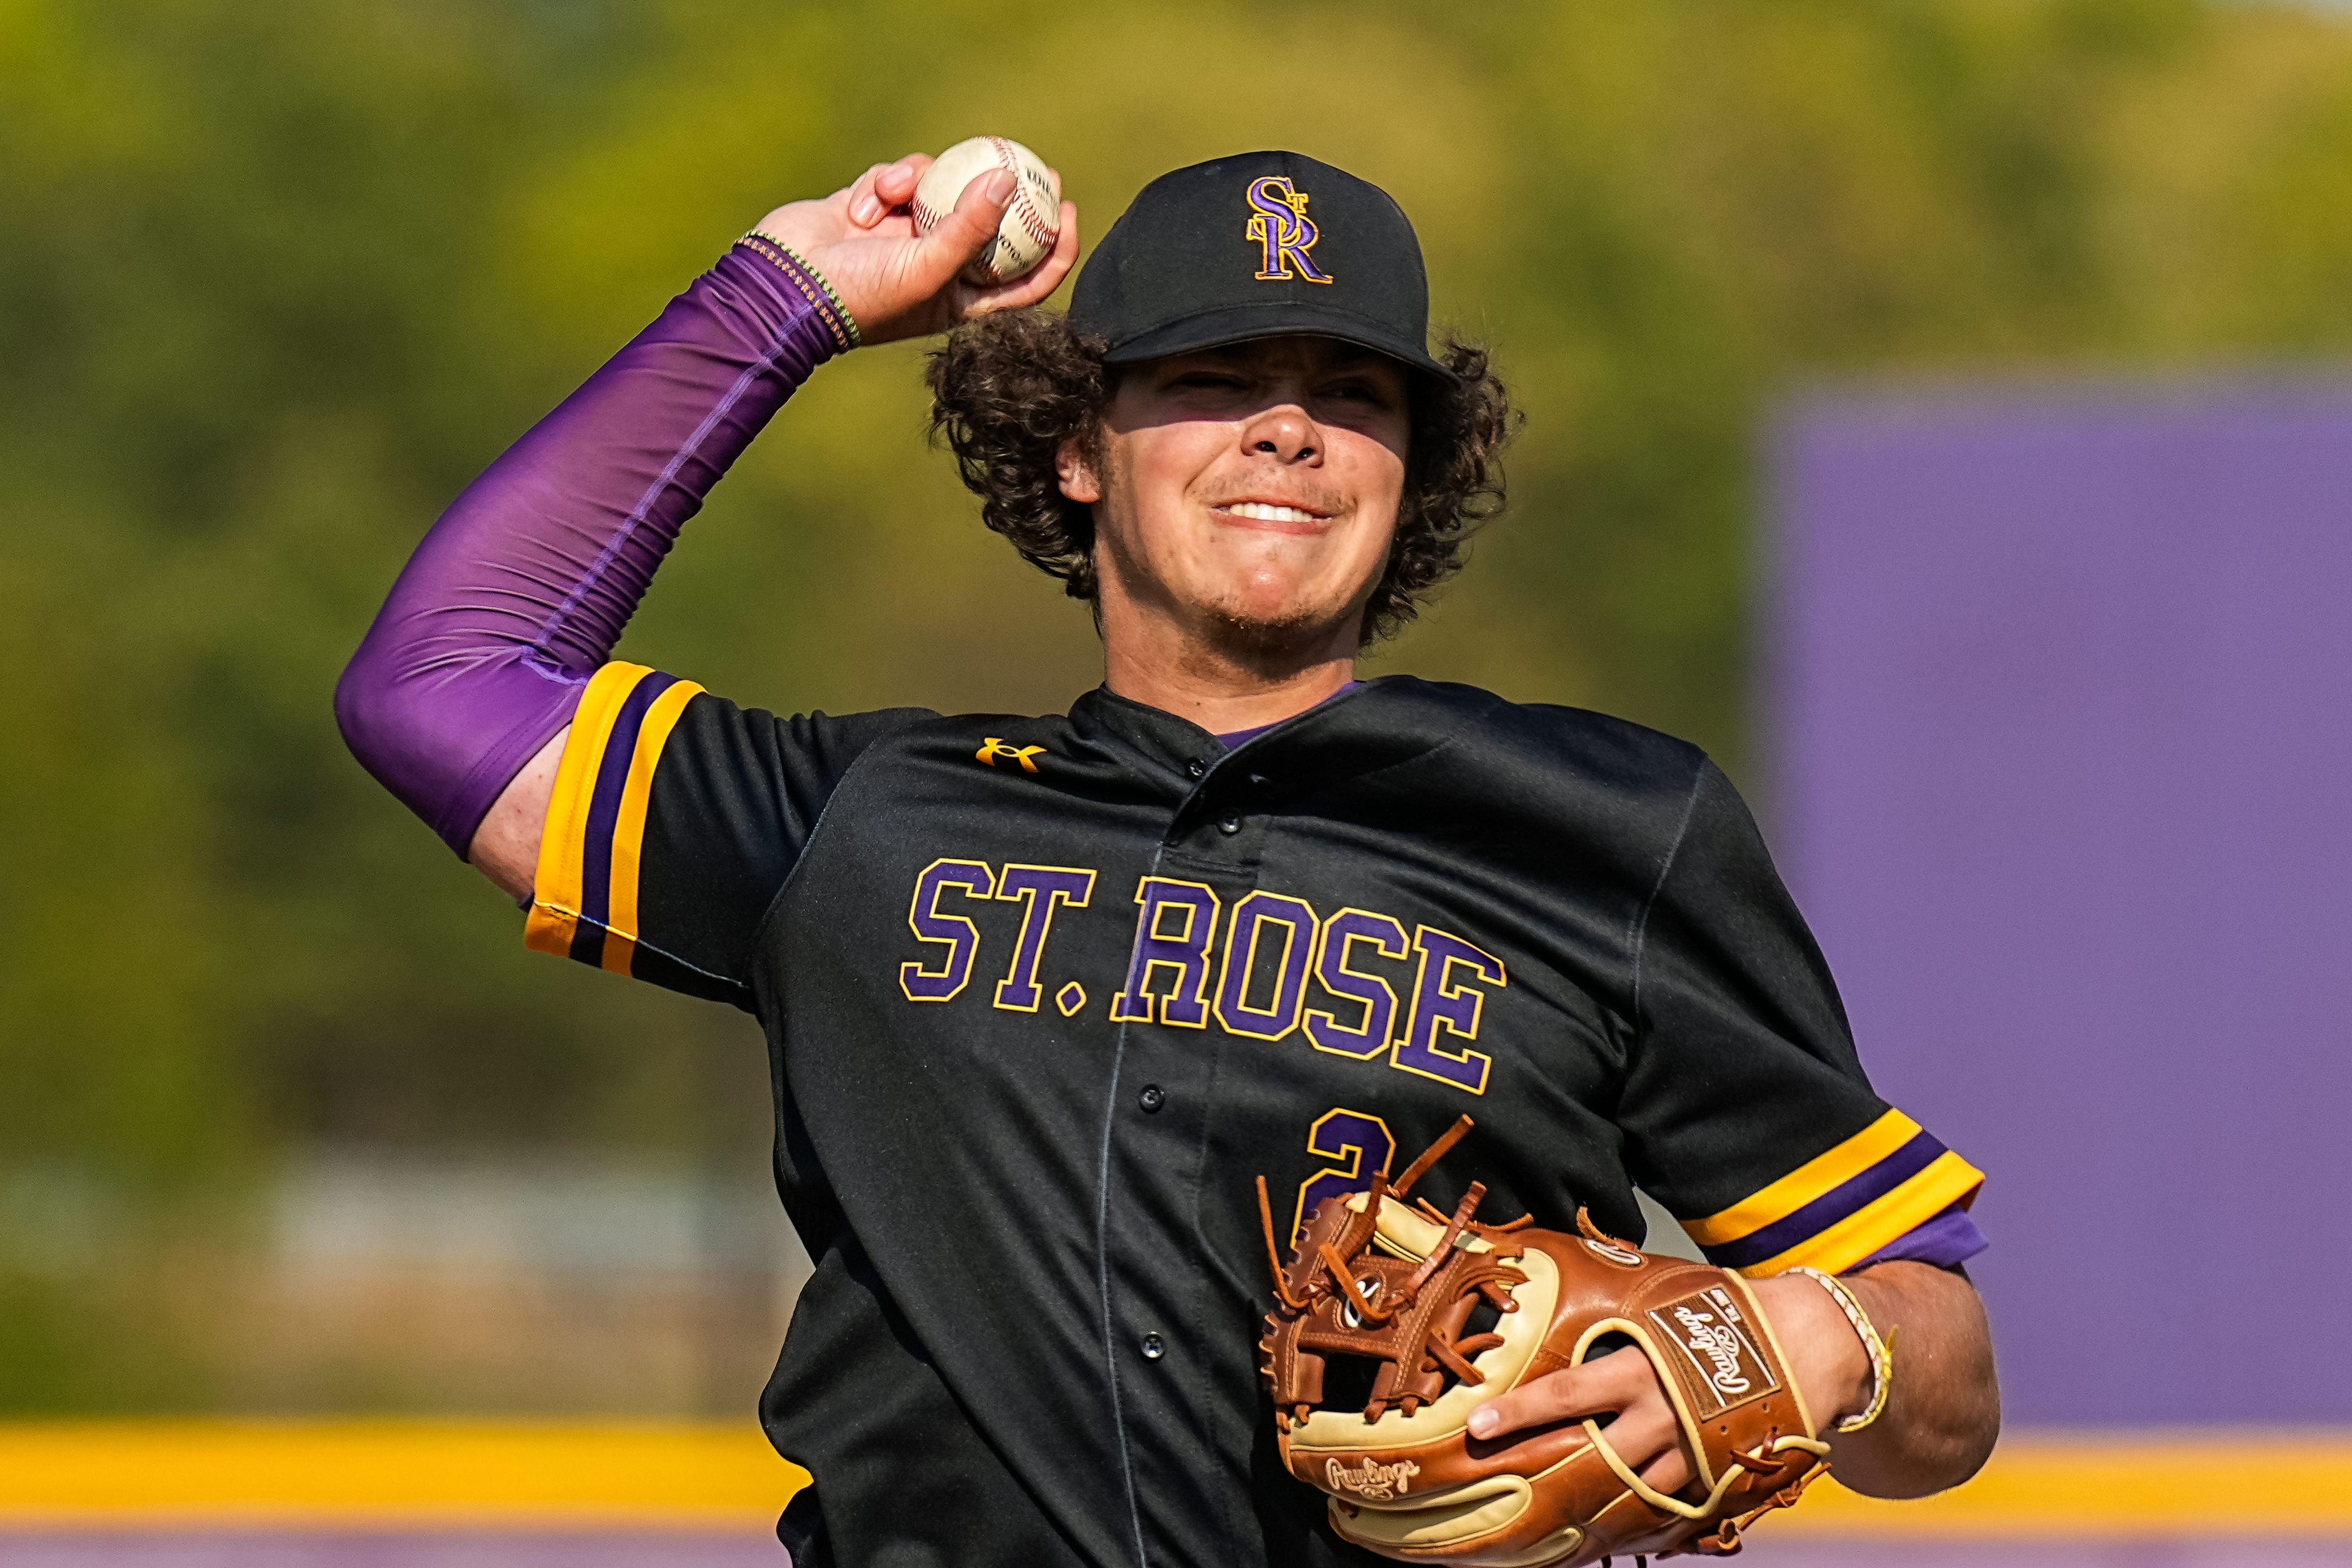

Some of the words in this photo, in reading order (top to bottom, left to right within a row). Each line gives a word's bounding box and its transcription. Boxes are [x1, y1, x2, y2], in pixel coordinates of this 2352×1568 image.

[899, 857, 1097, 1017] ST.
[1109, 876, 1507, 1095] ROSE
[1290, 1107, 1396, 1248] 2
[1674, 1306, 1751, 1394] Rawlings
[1325, 1457, 1421, 1494] Rawlings
